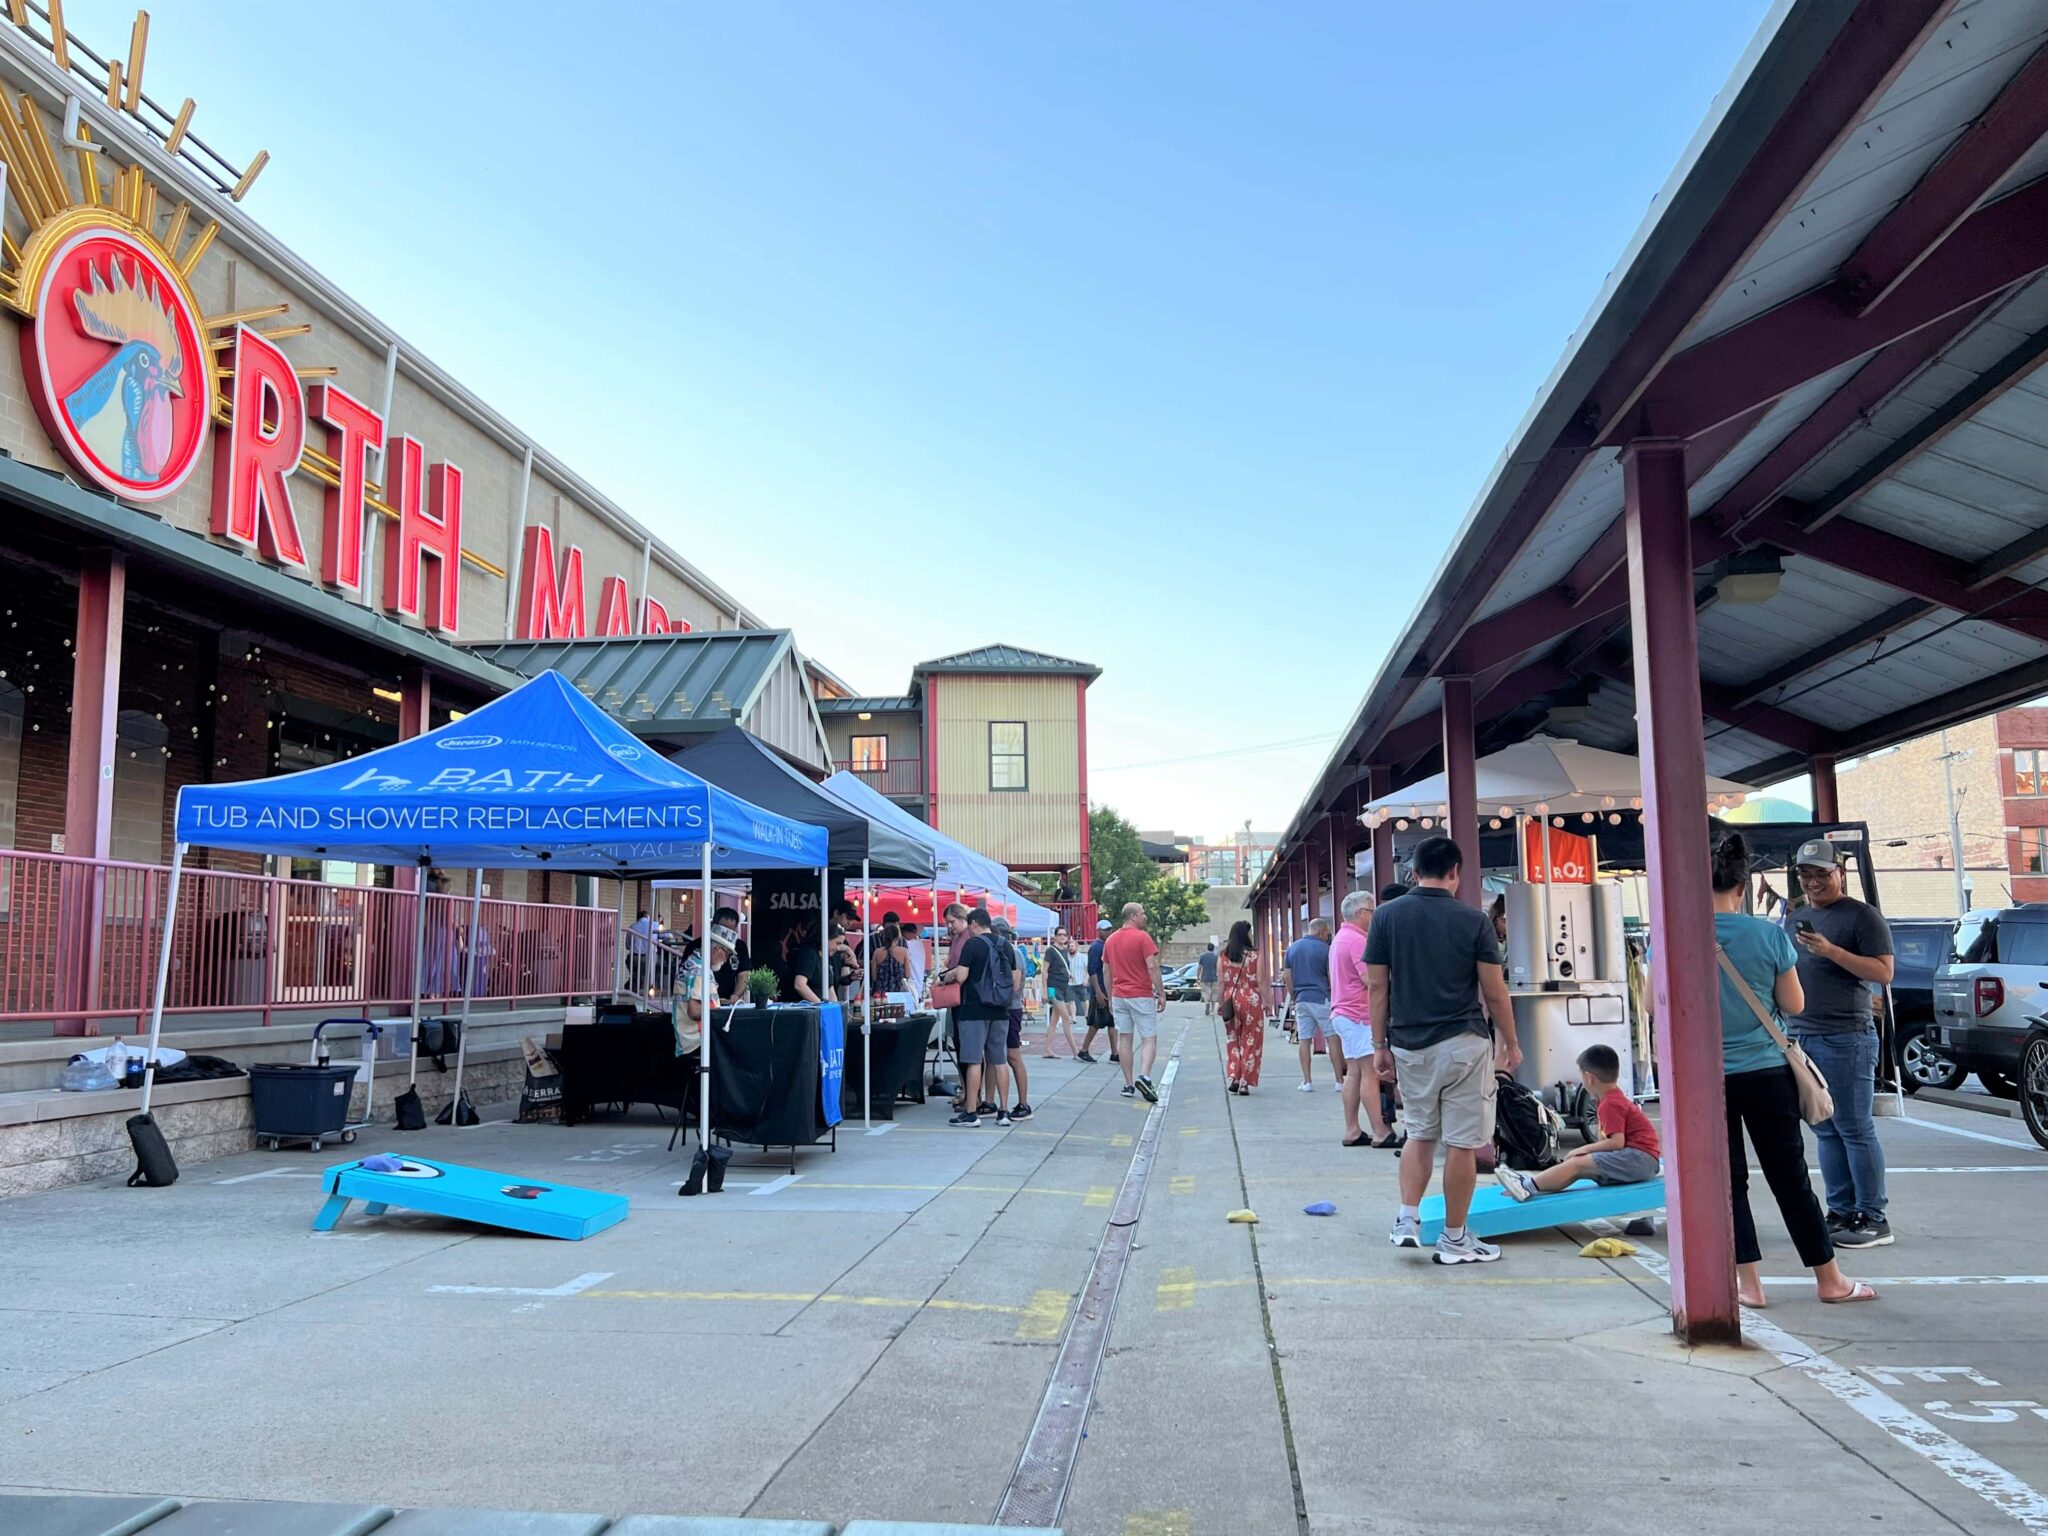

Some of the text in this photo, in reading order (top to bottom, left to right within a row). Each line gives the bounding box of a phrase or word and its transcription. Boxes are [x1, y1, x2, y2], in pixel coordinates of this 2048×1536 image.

[428, 767, 605, 787] BATH
[191, 804, 702, 830] TUB AND SHOWER REPLACEMENTS
[752, 820, 804, 850] WALK-IN TUBS
[1534, 861, 1585, 879] ZROZ
[769, 892, 822, 910] SALSA
